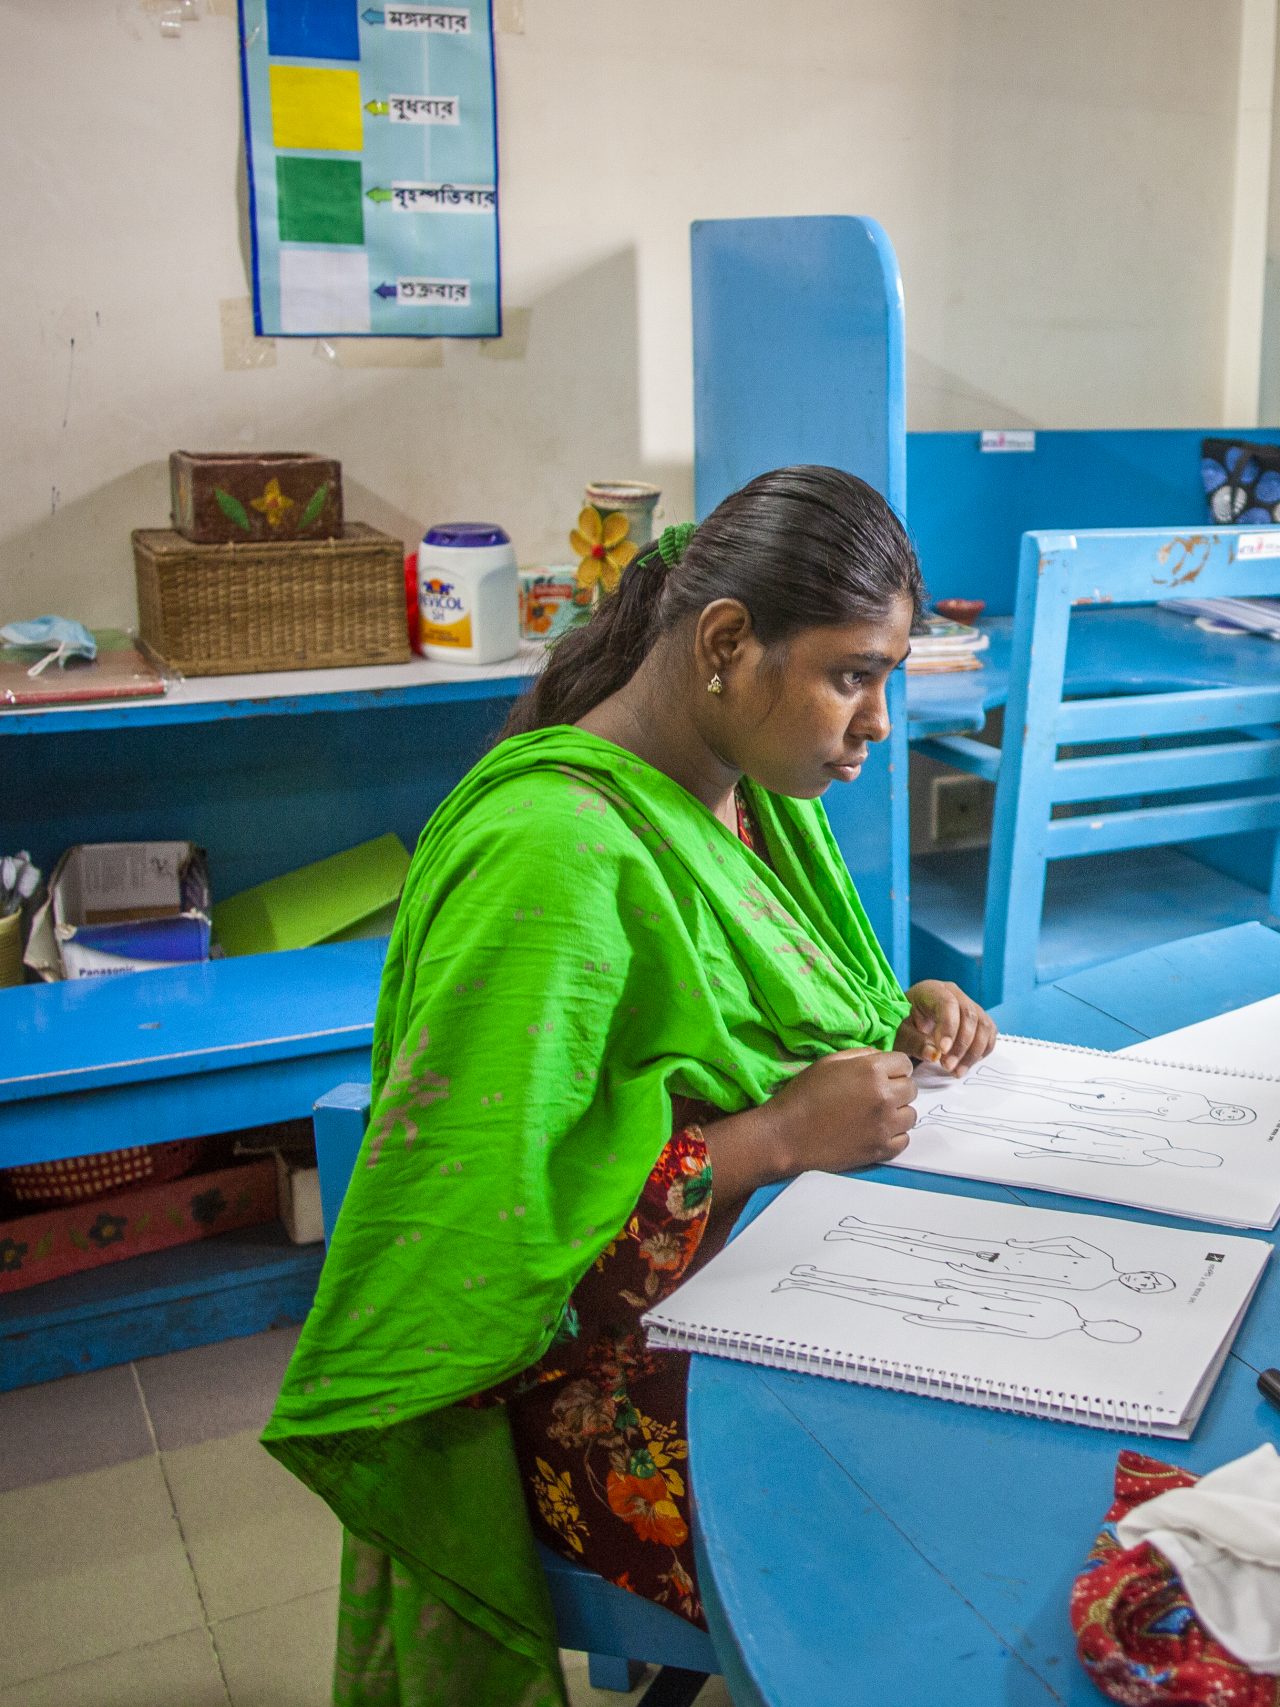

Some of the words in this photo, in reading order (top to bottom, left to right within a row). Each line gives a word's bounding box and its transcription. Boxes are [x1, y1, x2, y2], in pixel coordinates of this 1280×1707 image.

[388, 11, 467, 33] মঙ্গলবার
[391, 98, 455, 121] বুধবার
[393, 183, 495, 209] বৃহস্পতিবার
[400, 282, 468, 302] শুক্রবার
